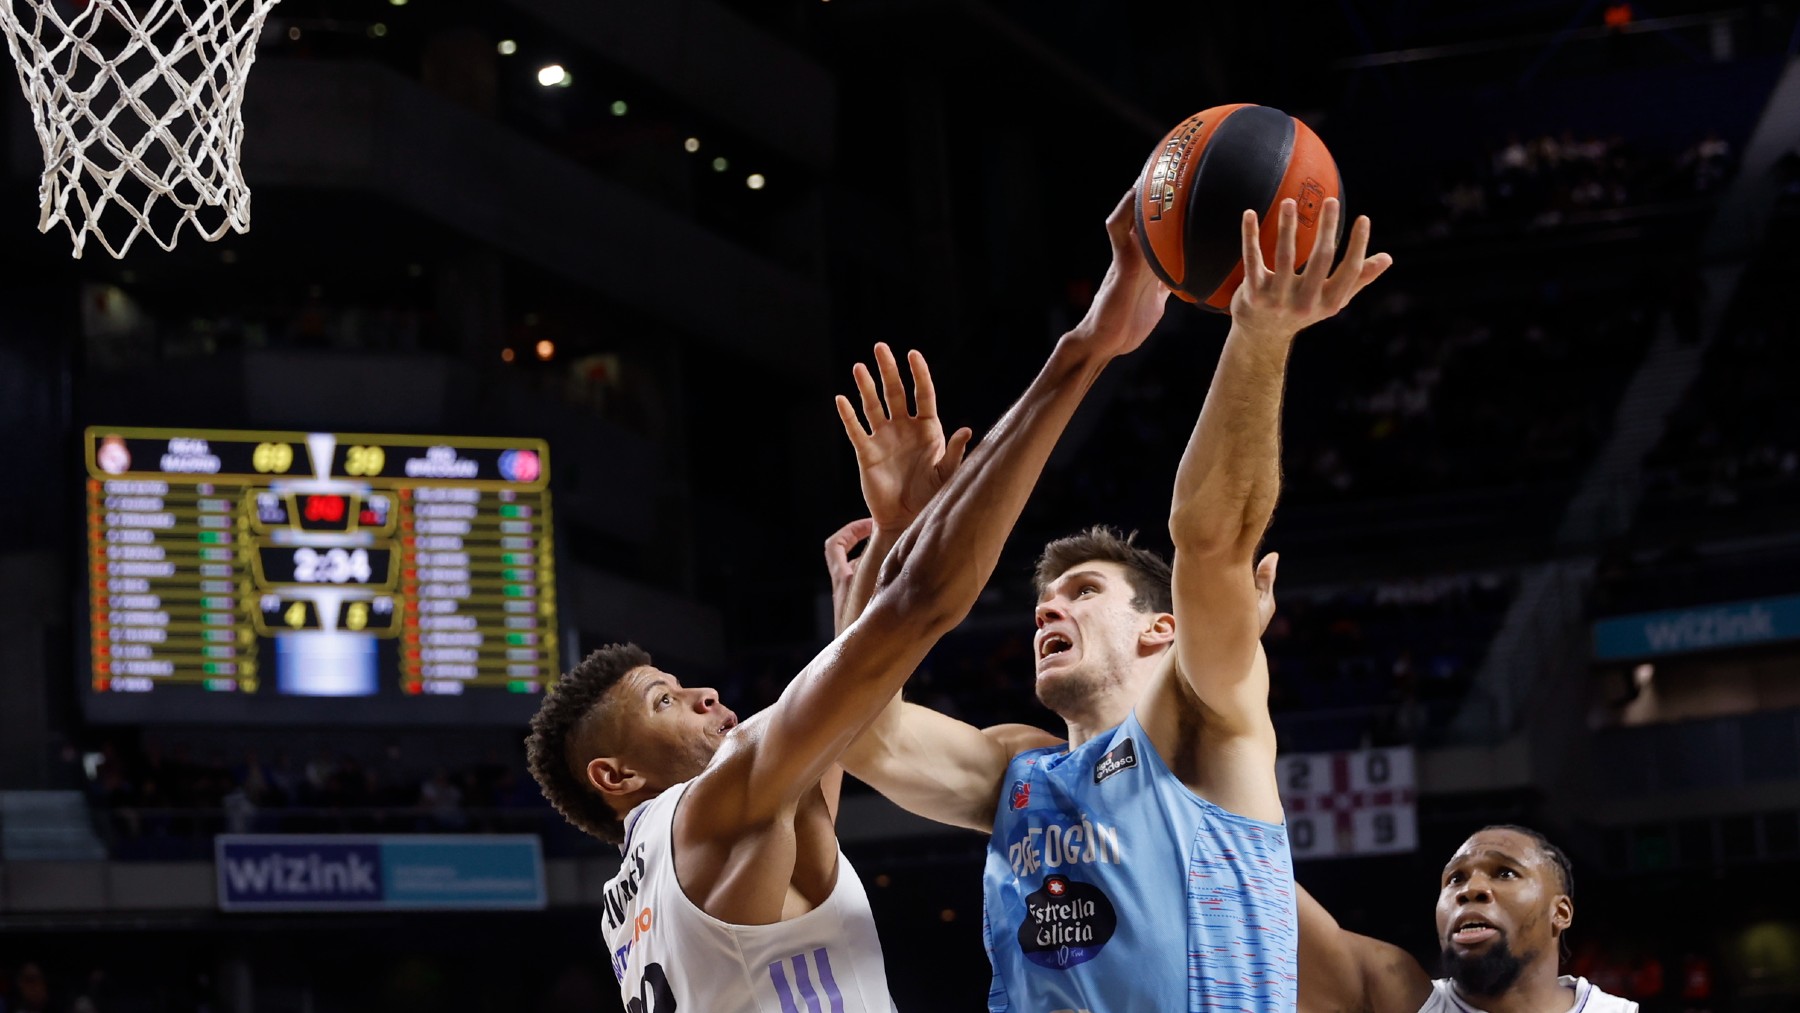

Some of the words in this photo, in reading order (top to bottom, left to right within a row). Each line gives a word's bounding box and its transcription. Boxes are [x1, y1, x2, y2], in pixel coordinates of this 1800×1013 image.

[294, 548, 372, 583] 2:34
[1029, 898, 1095, 924] Estrella
[1036, 921, 1093, 946] Galicia
